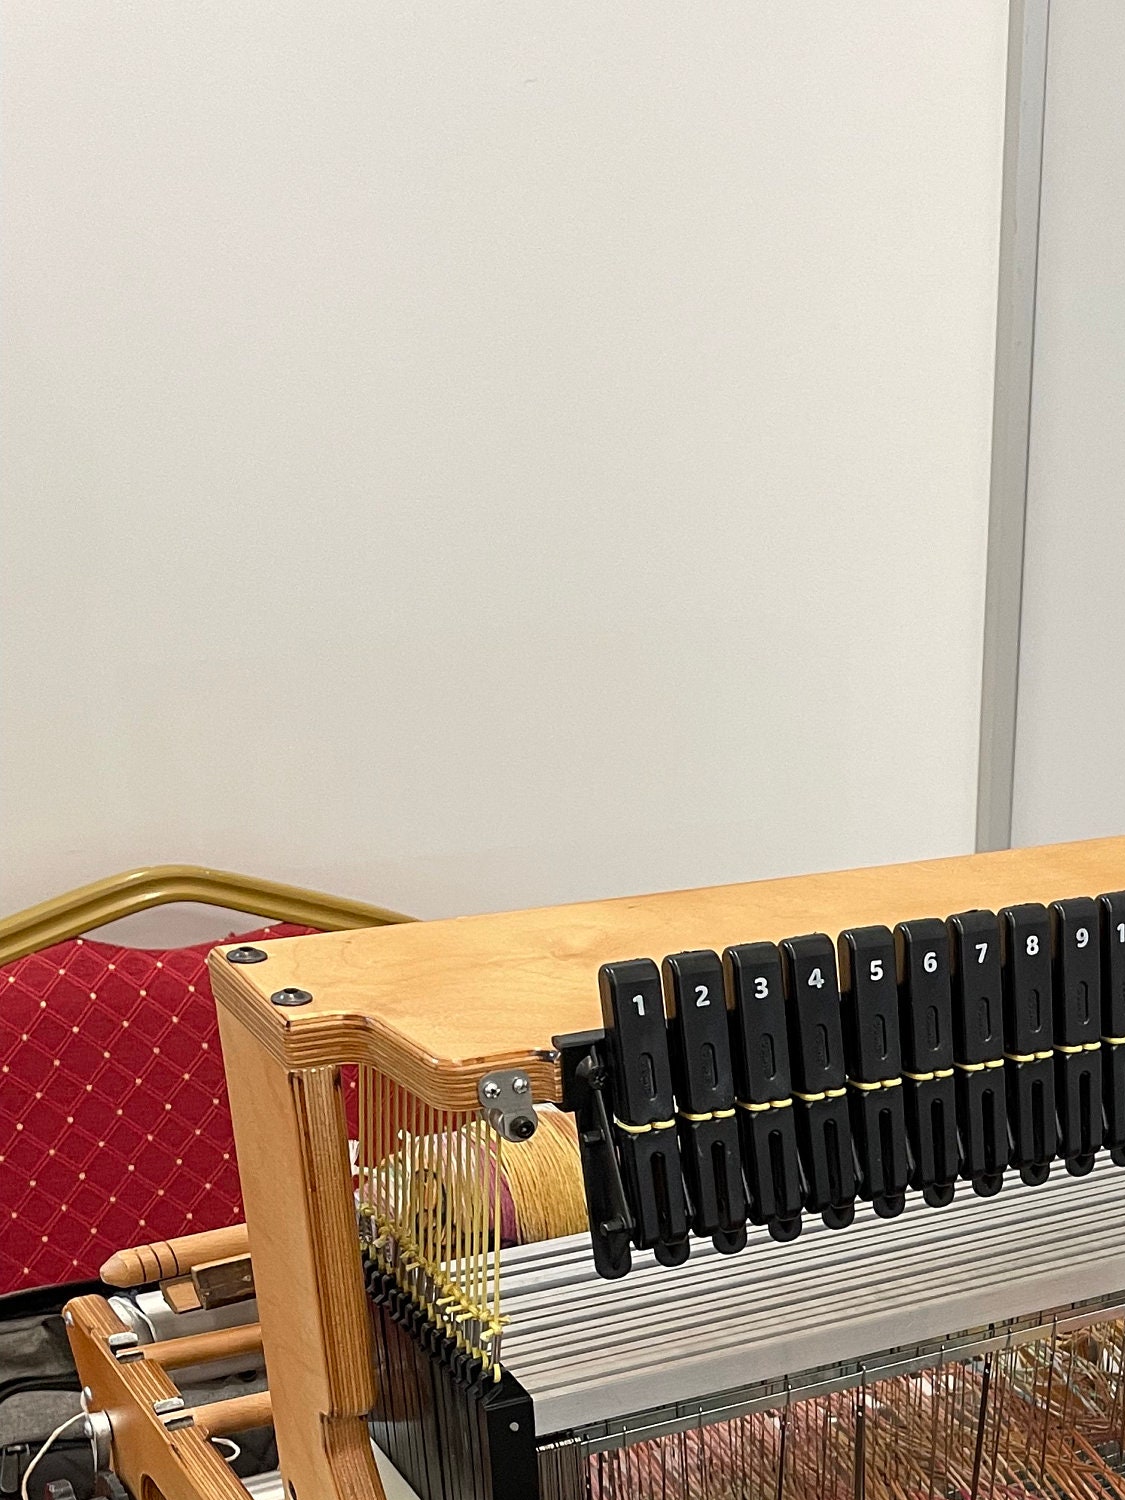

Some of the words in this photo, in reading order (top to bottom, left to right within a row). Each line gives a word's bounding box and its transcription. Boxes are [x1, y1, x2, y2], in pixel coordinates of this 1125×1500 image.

[632, 994, 646, 1016] 1
[694, 985, 711, 1008] 2
[754, 976, 769, 999] 3
[807, 968, 825, 989] 4
[870, 959, 884, 981] 5
[923, 951, 938, 973] 6
[975, 942, 988, 964] 7
[1026, 935, 1040, 956] 8
[1075, 927, 1089, 948] 9
